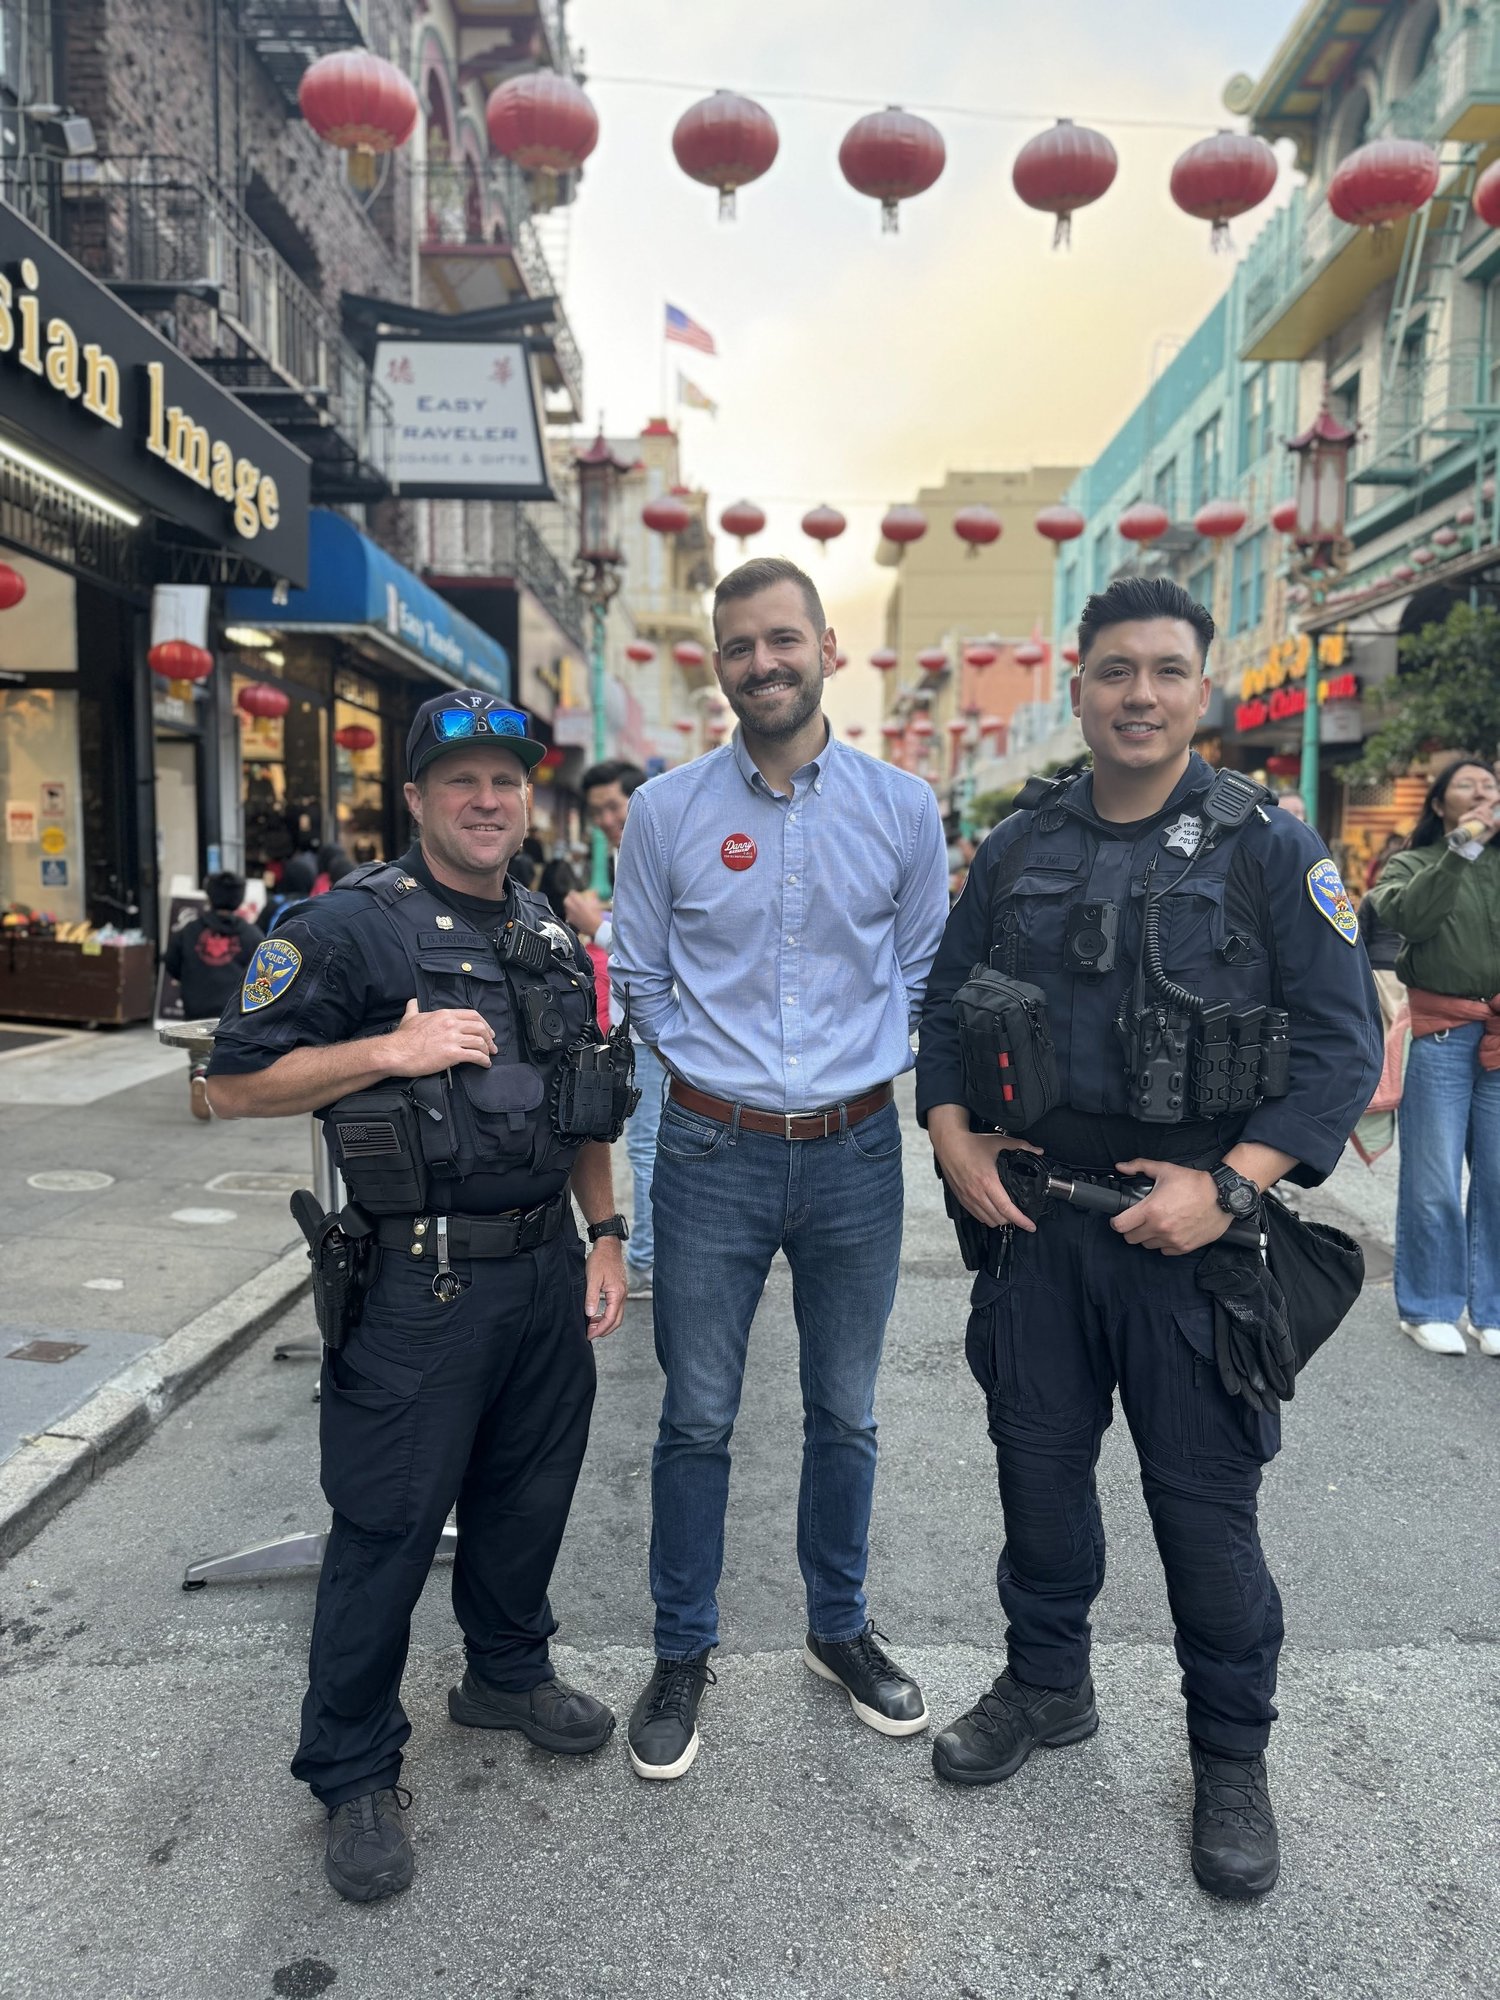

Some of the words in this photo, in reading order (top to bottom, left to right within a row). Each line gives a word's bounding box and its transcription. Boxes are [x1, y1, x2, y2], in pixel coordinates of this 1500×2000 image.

[401, 426, 518, 441] RAVELER
[147, 362, 279, 539] Image
[470, 696, 482, 708] F
[1227, 778, 1254, 793] MOTOROLA
[1170, 824, 1182, 834] SAN
[1184, 821, 1203, 829] FRANC
[265, 951, 287, 965] POLICE
